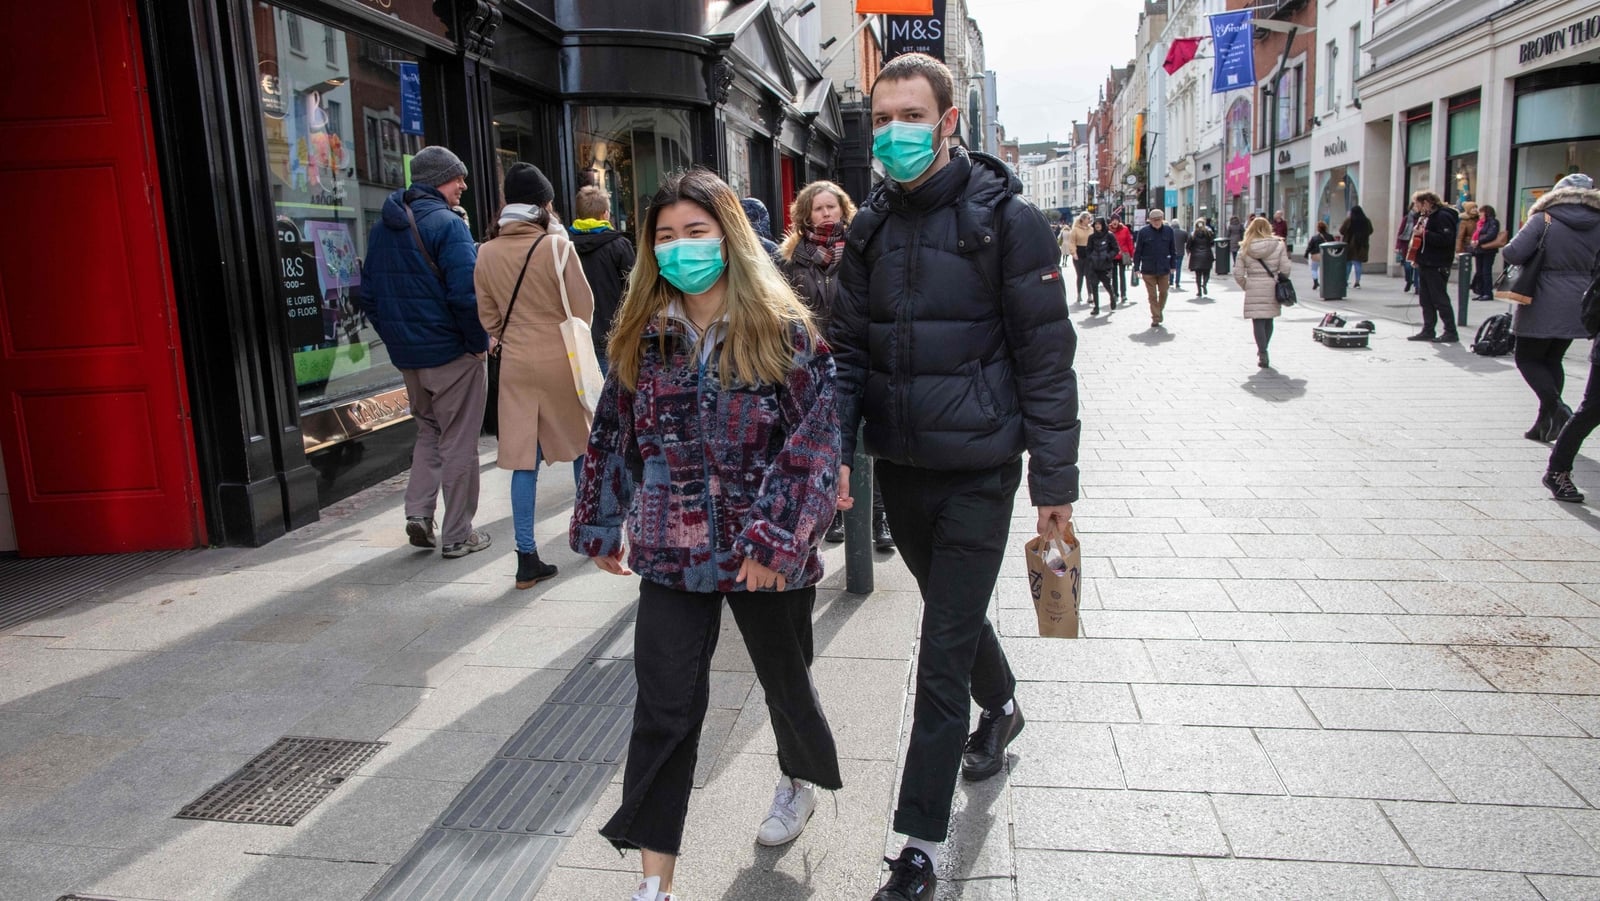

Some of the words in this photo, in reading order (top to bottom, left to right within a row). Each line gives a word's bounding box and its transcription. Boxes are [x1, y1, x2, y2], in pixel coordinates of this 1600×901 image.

[892, 19, 942, 41] M&S
[1519, 27, 1567, 64] BROWN
[1324, 136, 1348, 158] PANDORA
[281, 257, 304, 277] &S
[294, 295, 315, 305] LOWER
[297, 306, 318, 317] FLOOR
